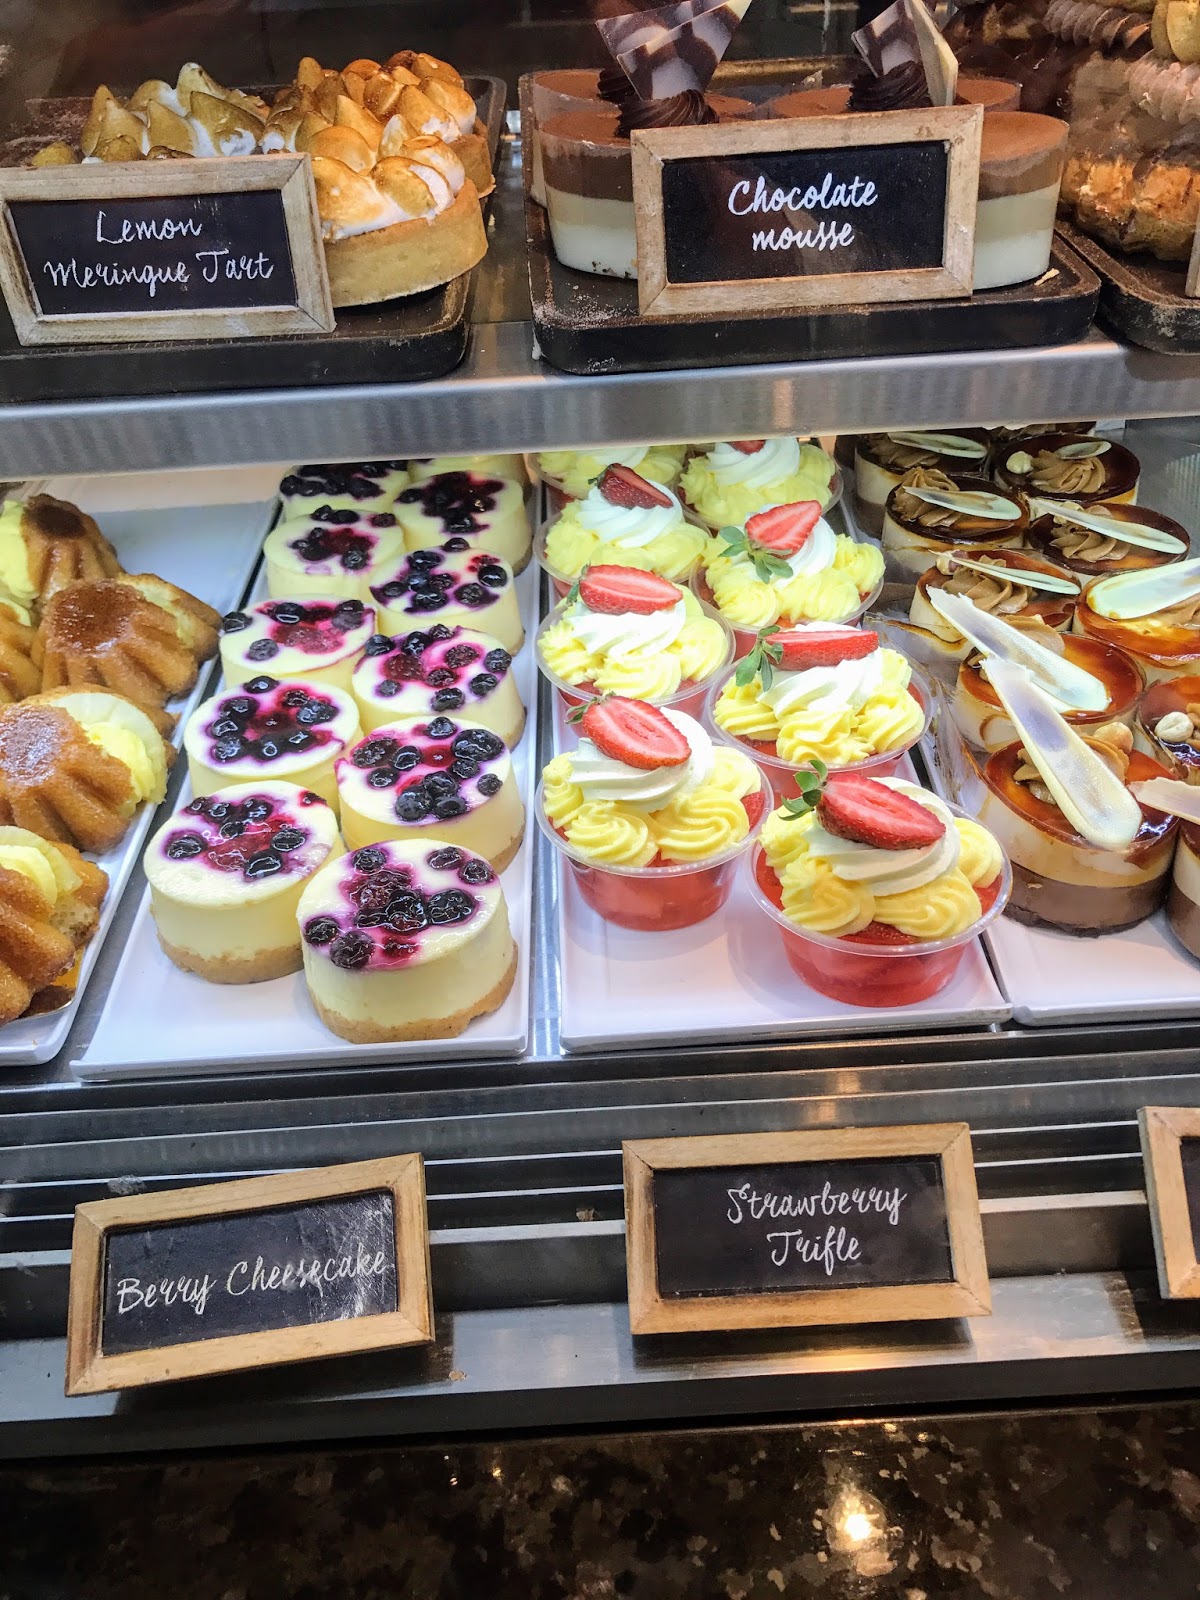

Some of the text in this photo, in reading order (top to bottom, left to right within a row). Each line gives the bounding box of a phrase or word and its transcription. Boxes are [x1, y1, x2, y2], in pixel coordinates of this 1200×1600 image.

[727, 172, 878, 216] Chocolate
[96, 210, 203, 244] Lemon
[752, 221, 855, 252] mousse
[43, 248, 274, 297] Meringue Tart
[726, 1181, 907, 1226] Strawberry
[767, 1225, 862, 1276] Trifle
[116, 1242, 387, 1315] Berry Cheesecake
